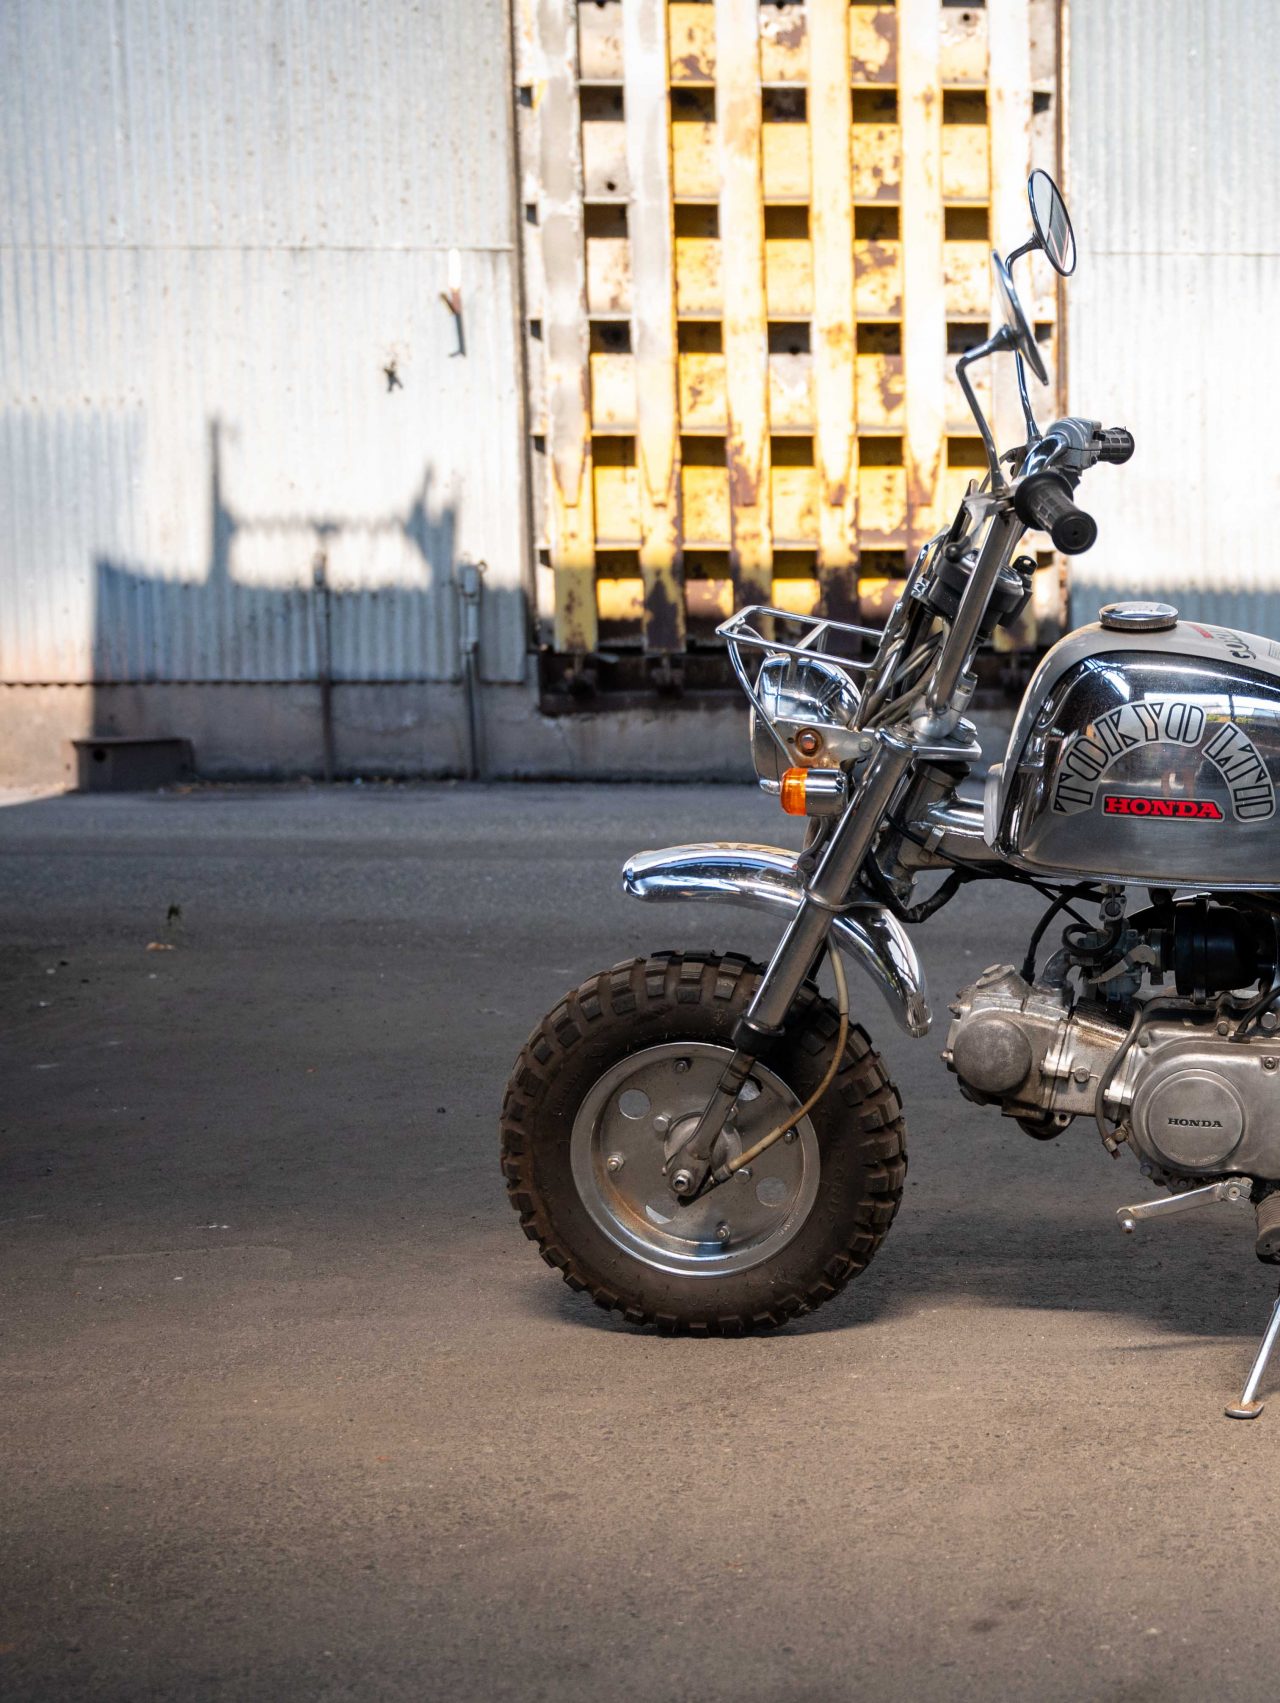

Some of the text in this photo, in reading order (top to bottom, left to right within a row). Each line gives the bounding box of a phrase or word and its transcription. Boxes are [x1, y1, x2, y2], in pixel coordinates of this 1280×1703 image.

[1053, 702, 1274, 820] TOKYO LTD
[1106, 797, 1222, 819] HONDA
[1167, 1117, 1223, 1128] HONDA
